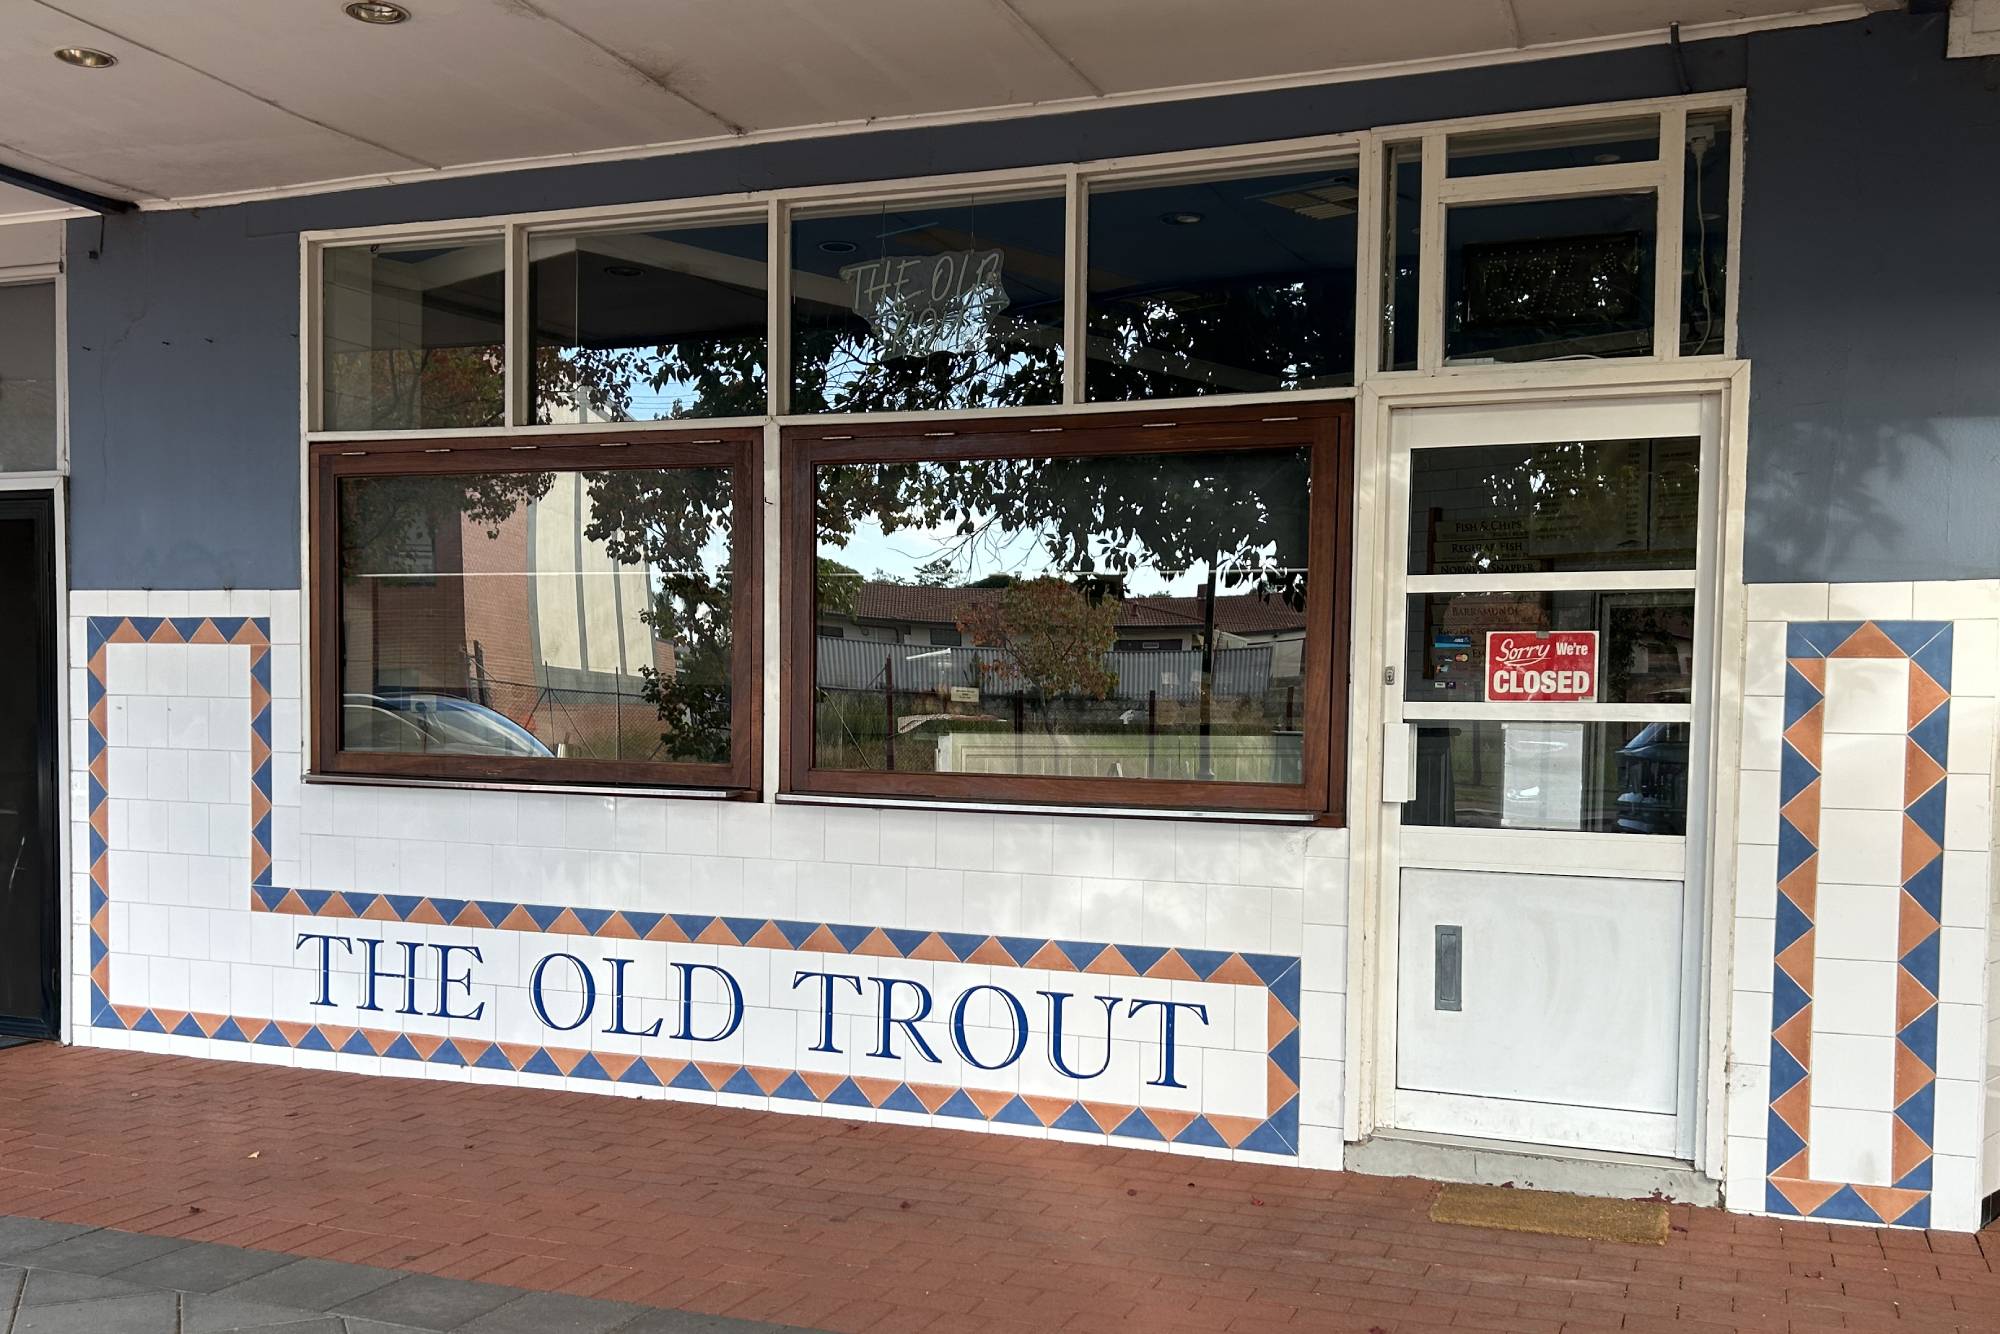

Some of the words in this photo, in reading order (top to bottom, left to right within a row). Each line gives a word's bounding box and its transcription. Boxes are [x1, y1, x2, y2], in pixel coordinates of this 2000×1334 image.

[848, 259, 924, 309] THE
[931, 252, 1000, 304] OLD
[1491, 520, 1521, 531] CHIPS
[1496, 639, 1550, 666] Sorry
[1556, 642, 1588, 656] We're
[1493, 670, 1590, 694] CLOSED
[296, 933, 485, 1021] THE
[529, 952, 744, 1042] OLD
[792, 970, 1209, 1088] TROUT
